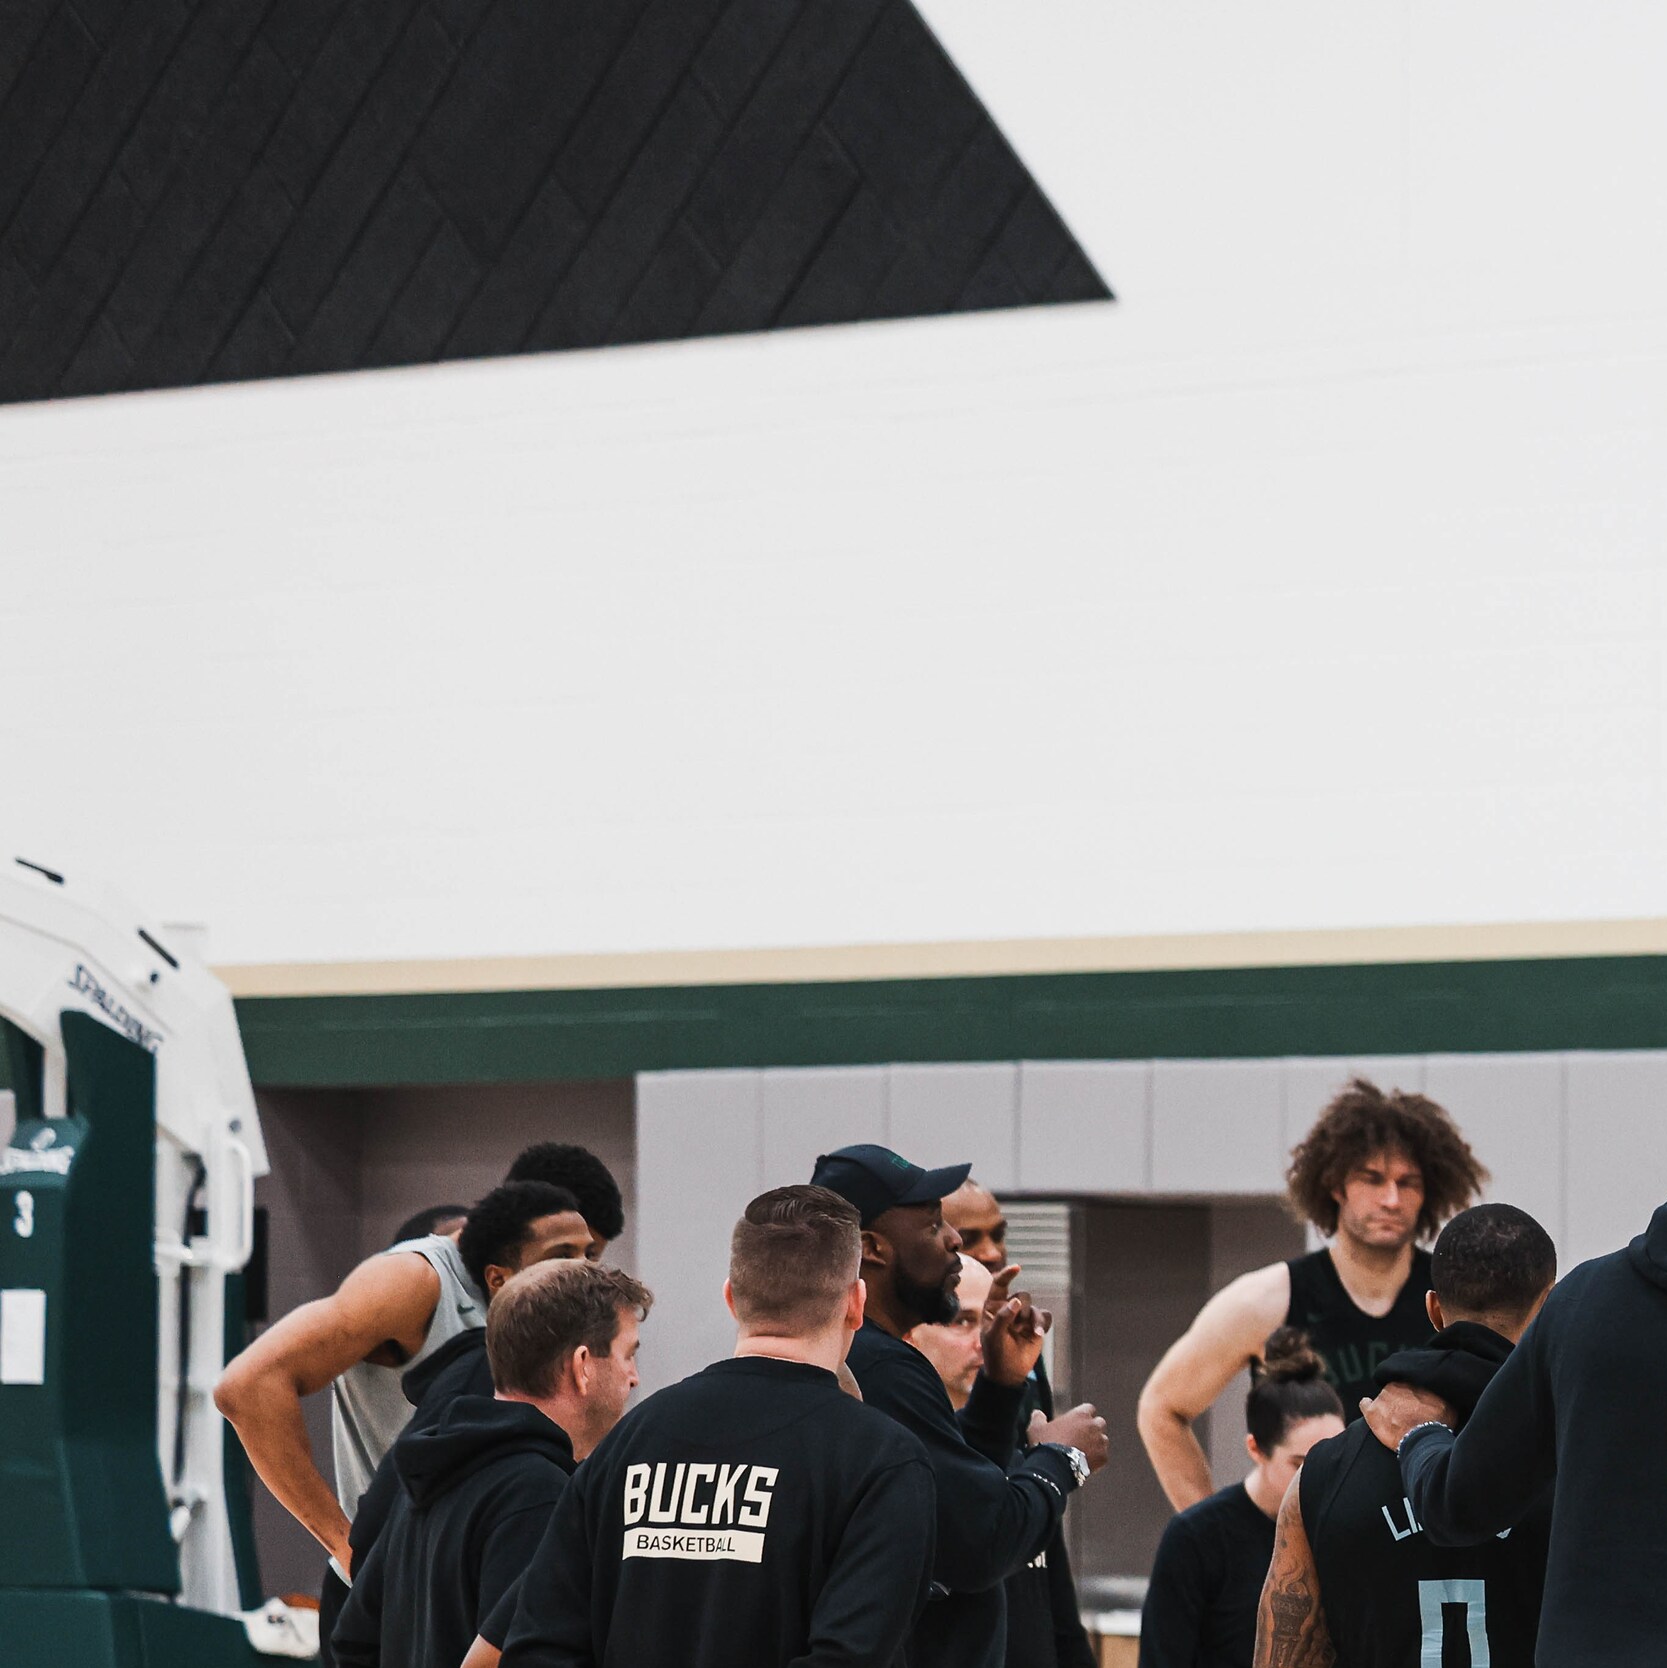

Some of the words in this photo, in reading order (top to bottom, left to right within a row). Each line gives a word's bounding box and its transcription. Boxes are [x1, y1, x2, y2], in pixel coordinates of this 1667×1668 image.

[14, 1190, 34, 1238] 3
[624, 1462, 780, 1528] BUCKS
[636, 1534, 736, 1553] BASKETBALL
